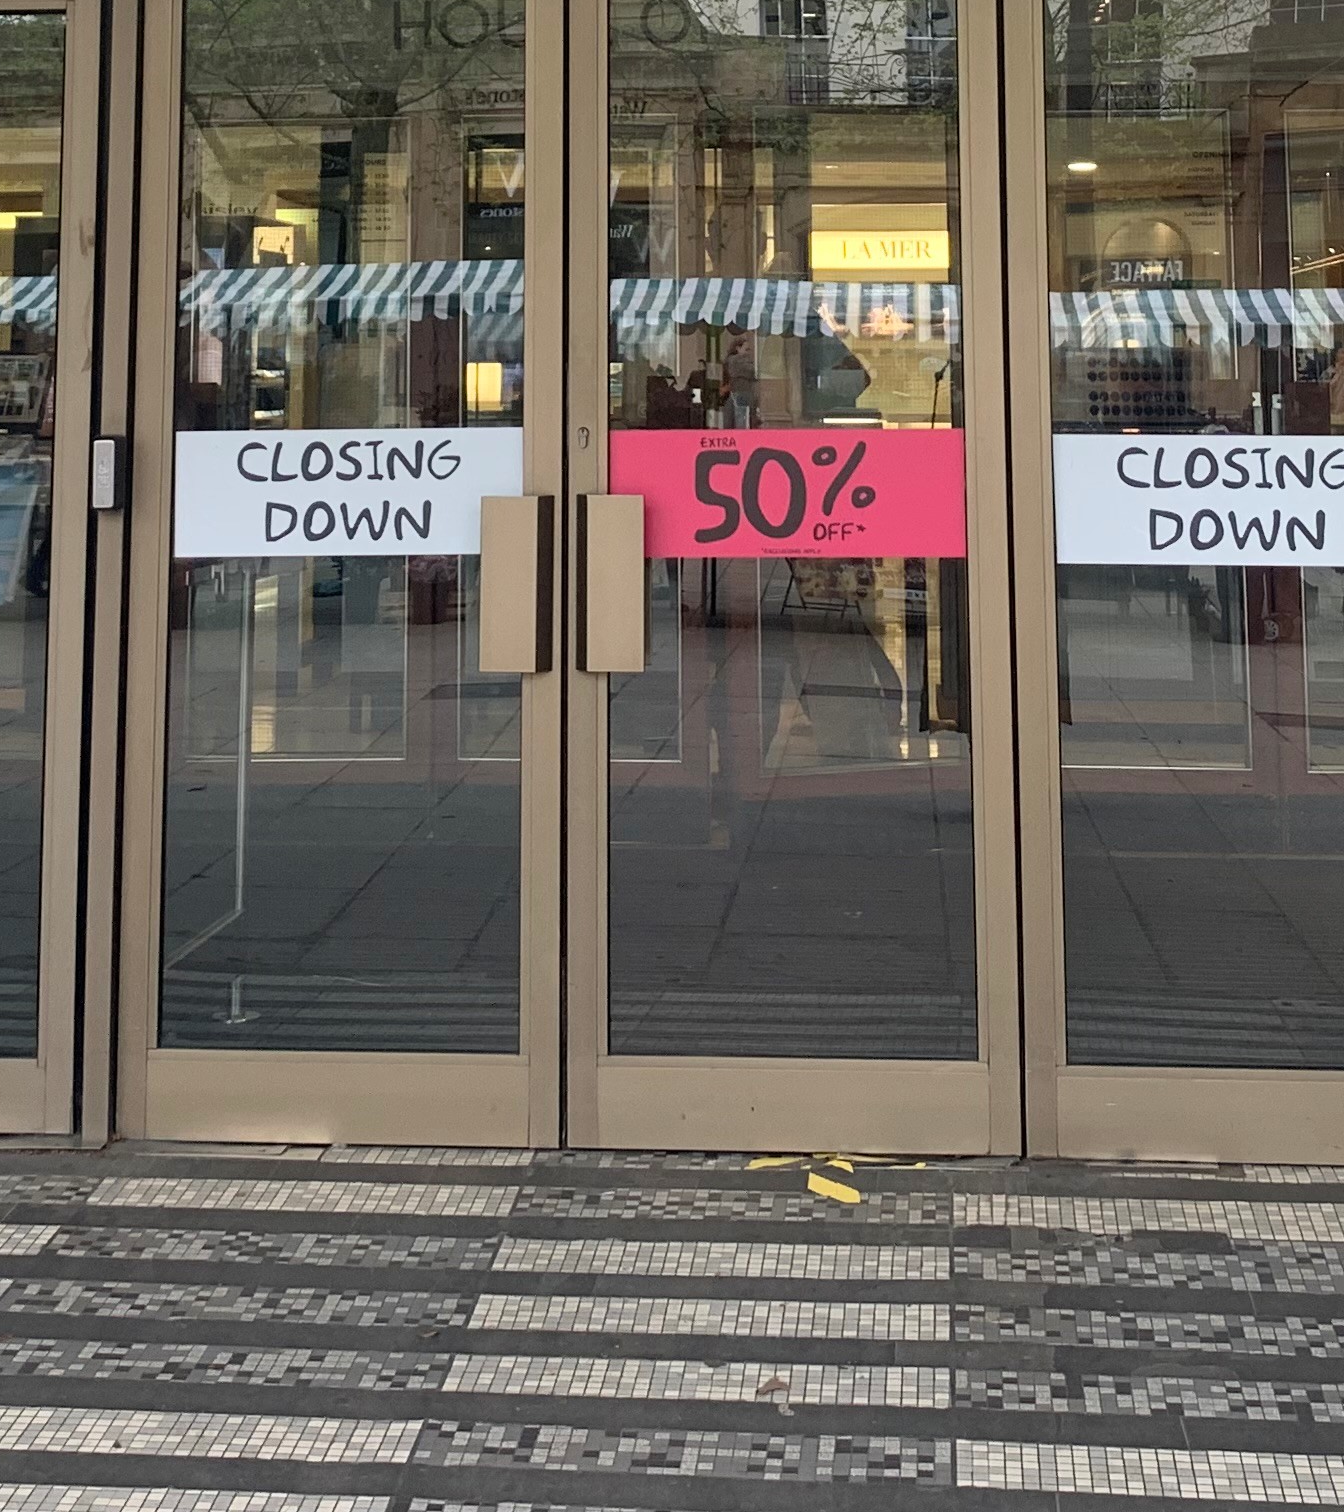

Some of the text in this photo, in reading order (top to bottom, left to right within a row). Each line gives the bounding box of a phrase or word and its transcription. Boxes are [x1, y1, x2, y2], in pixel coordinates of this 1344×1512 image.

[842, 240, 932, 259] LA MER
[237, 439, 461, 483] CLOSING
[700, 437, 736, 448] EXTRA
[694, 441, 876, 543] 50%
[265, 500, 432, 543] DOWN
[1149, 509, 1326, 552] DOWN
